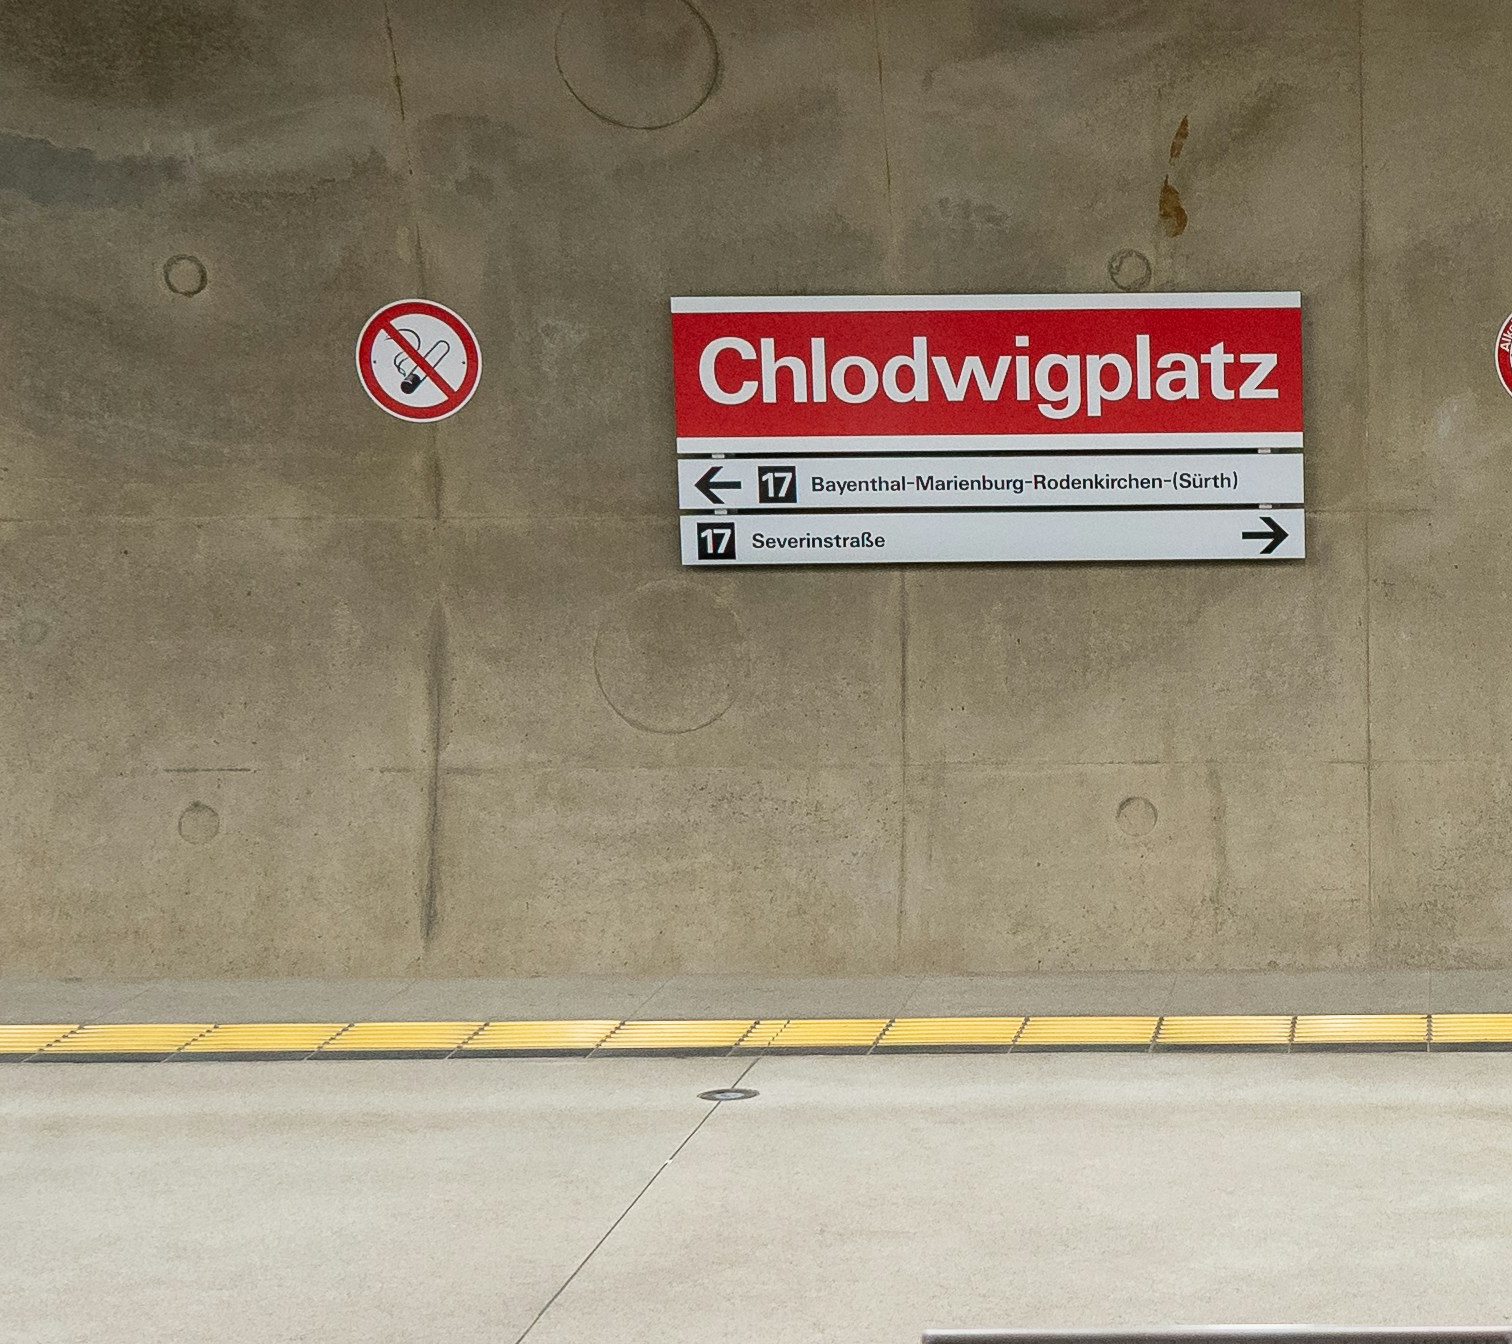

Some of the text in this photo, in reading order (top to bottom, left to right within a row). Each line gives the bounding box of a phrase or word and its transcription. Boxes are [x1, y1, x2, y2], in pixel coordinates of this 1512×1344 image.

[697, 334, 1280, 420] Chlodwigplatz
[761, 469, 1239, 500] 17 Bayenthal-Marienburg-Rodenkirchen-(Sürth)
[700, 527, 886, 555] 17 Severinstraße
